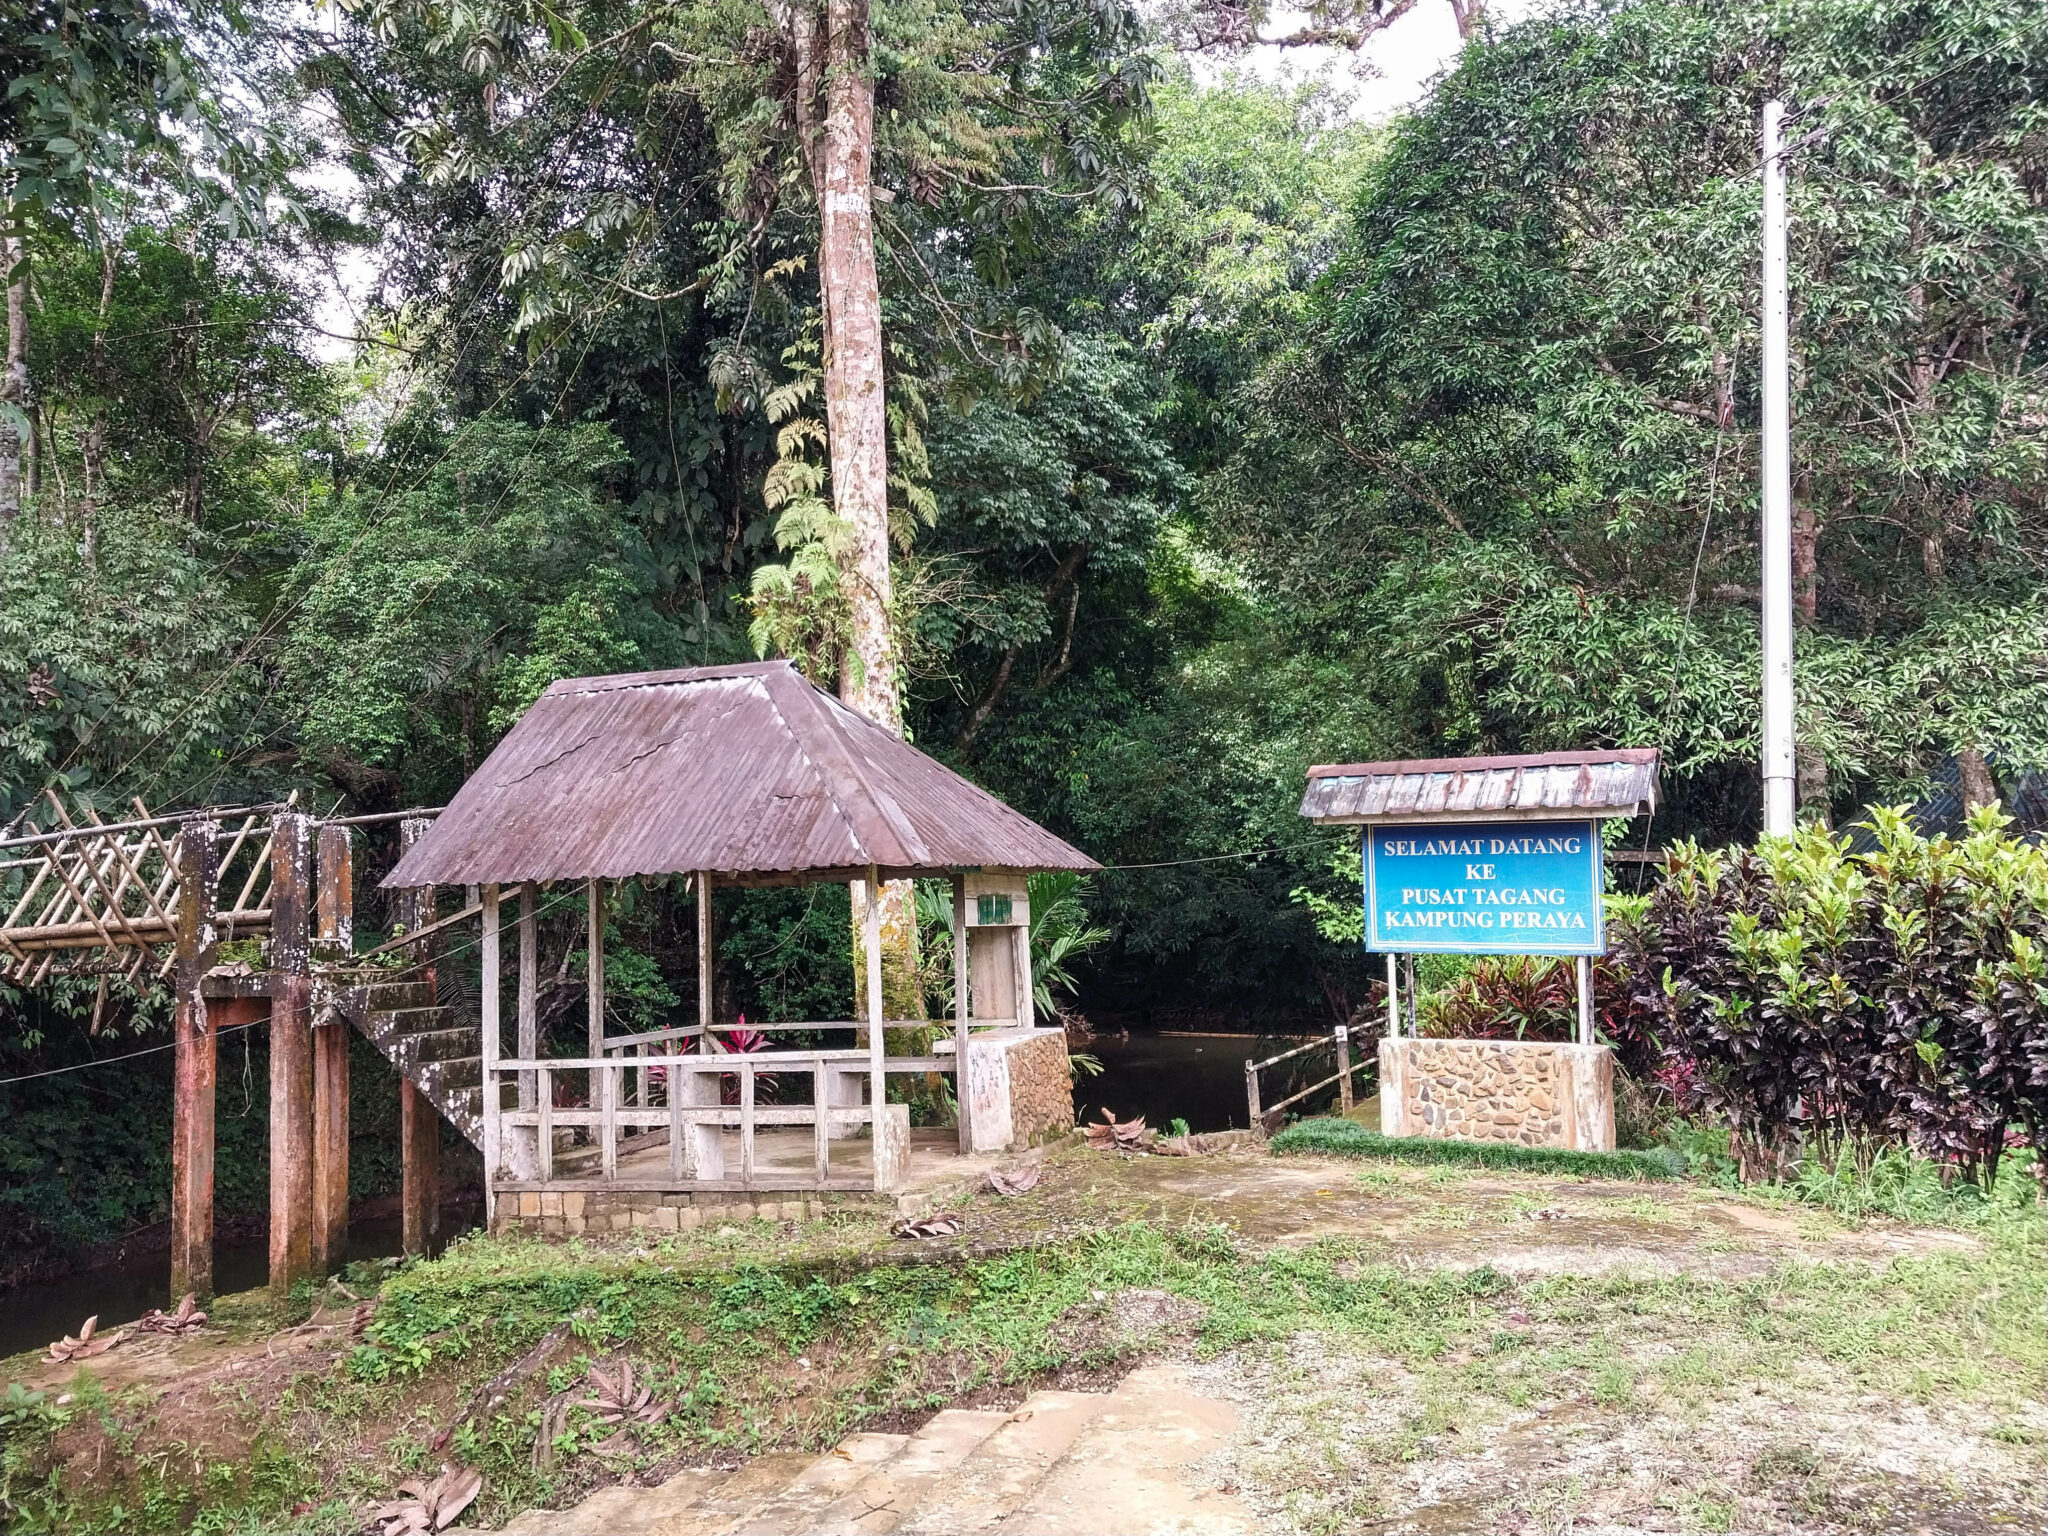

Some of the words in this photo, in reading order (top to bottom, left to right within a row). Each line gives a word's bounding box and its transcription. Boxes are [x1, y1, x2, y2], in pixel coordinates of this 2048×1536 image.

[1384, 840, 1484, 856] SELAMAT
[1490, 837, 1581, 855] DATANG
[1465, 864, 1496, 880] KE
[1402, 889, 1467, 905] PUSAT
[1472, 889, 1566, 905] TAGANG
[1384, 911, 1493, 928] KAMPUNG
[1499, 911, 1586, 929] PERAYA
